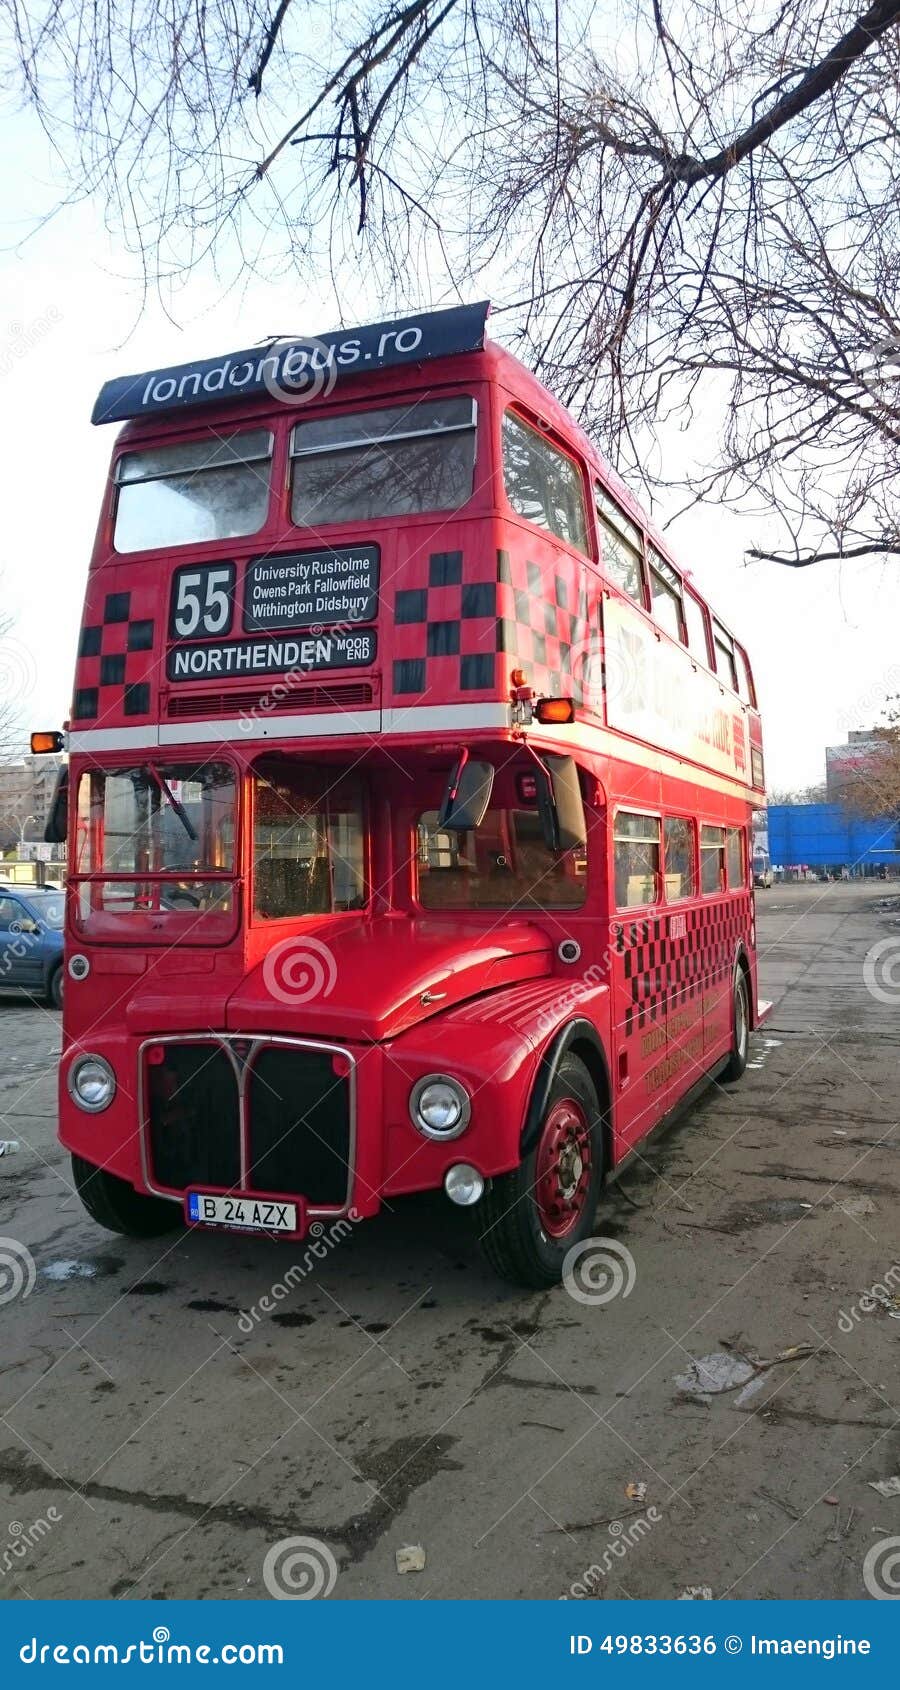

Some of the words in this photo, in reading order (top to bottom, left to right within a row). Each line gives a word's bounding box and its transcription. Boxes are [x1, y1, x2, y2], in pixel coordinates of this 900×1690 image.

[142, 327, 422, 404] londonbus.ro
[254, 563, 310, 582] University
[312, 558, 370, 576] Rusholme
[253, 585, 287, 600] Owens
[288, 581, 311, 597] Park
[314, 574, 370, 593] Fallowfield
[175, 570, 230, 636] 55
[252, 602, 312, 619] Withington
[315, 596, 369, 613] Didsbury
[174, 639, 332, 675] NORTHENDEN
[336, 637, 370, 651] MOOR
[346, 648, 370, 661] END
[203, 1198, 217, 1218] B
[224, 1201, 245, 1222] 24
[252, 1203, 289, 1227] AZX
